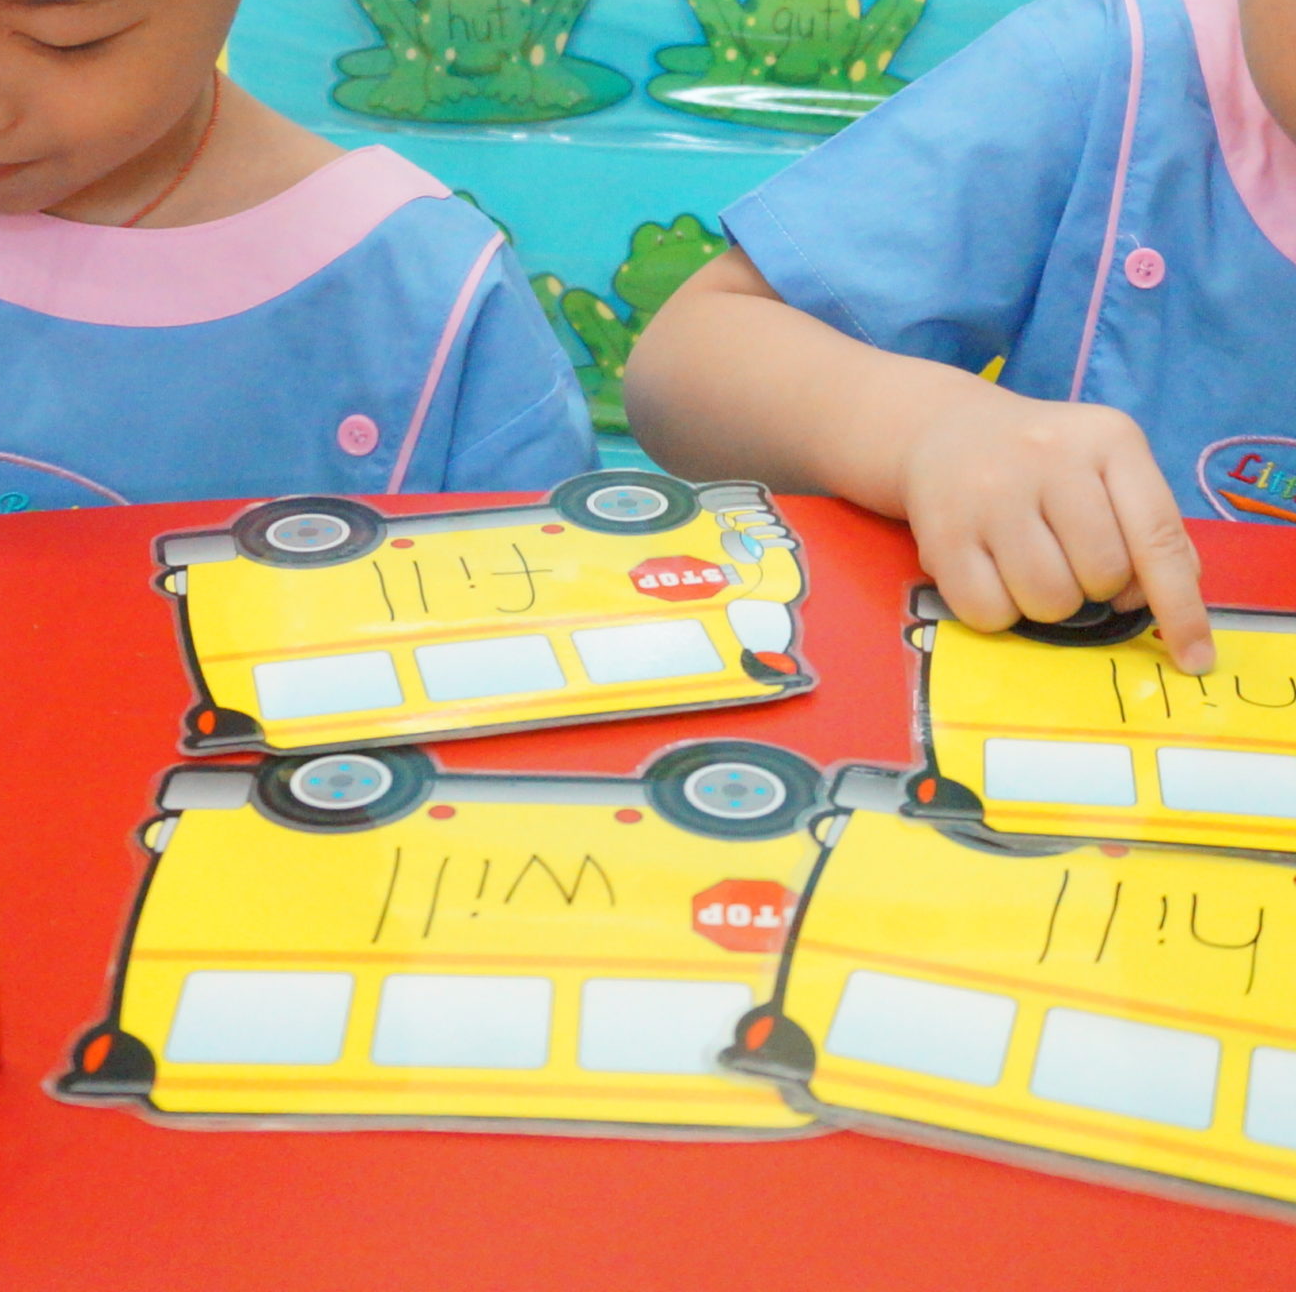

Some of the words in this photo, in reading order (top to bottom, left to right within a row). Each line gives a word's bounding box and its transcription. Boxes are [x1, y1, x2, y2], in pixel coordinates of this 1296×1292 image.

[372, 543, 553, 621] fill
[637, 568, 724, 589] STOP
[373, 847, 616, 944] will
[1038, 869, 1264, 995] hill
